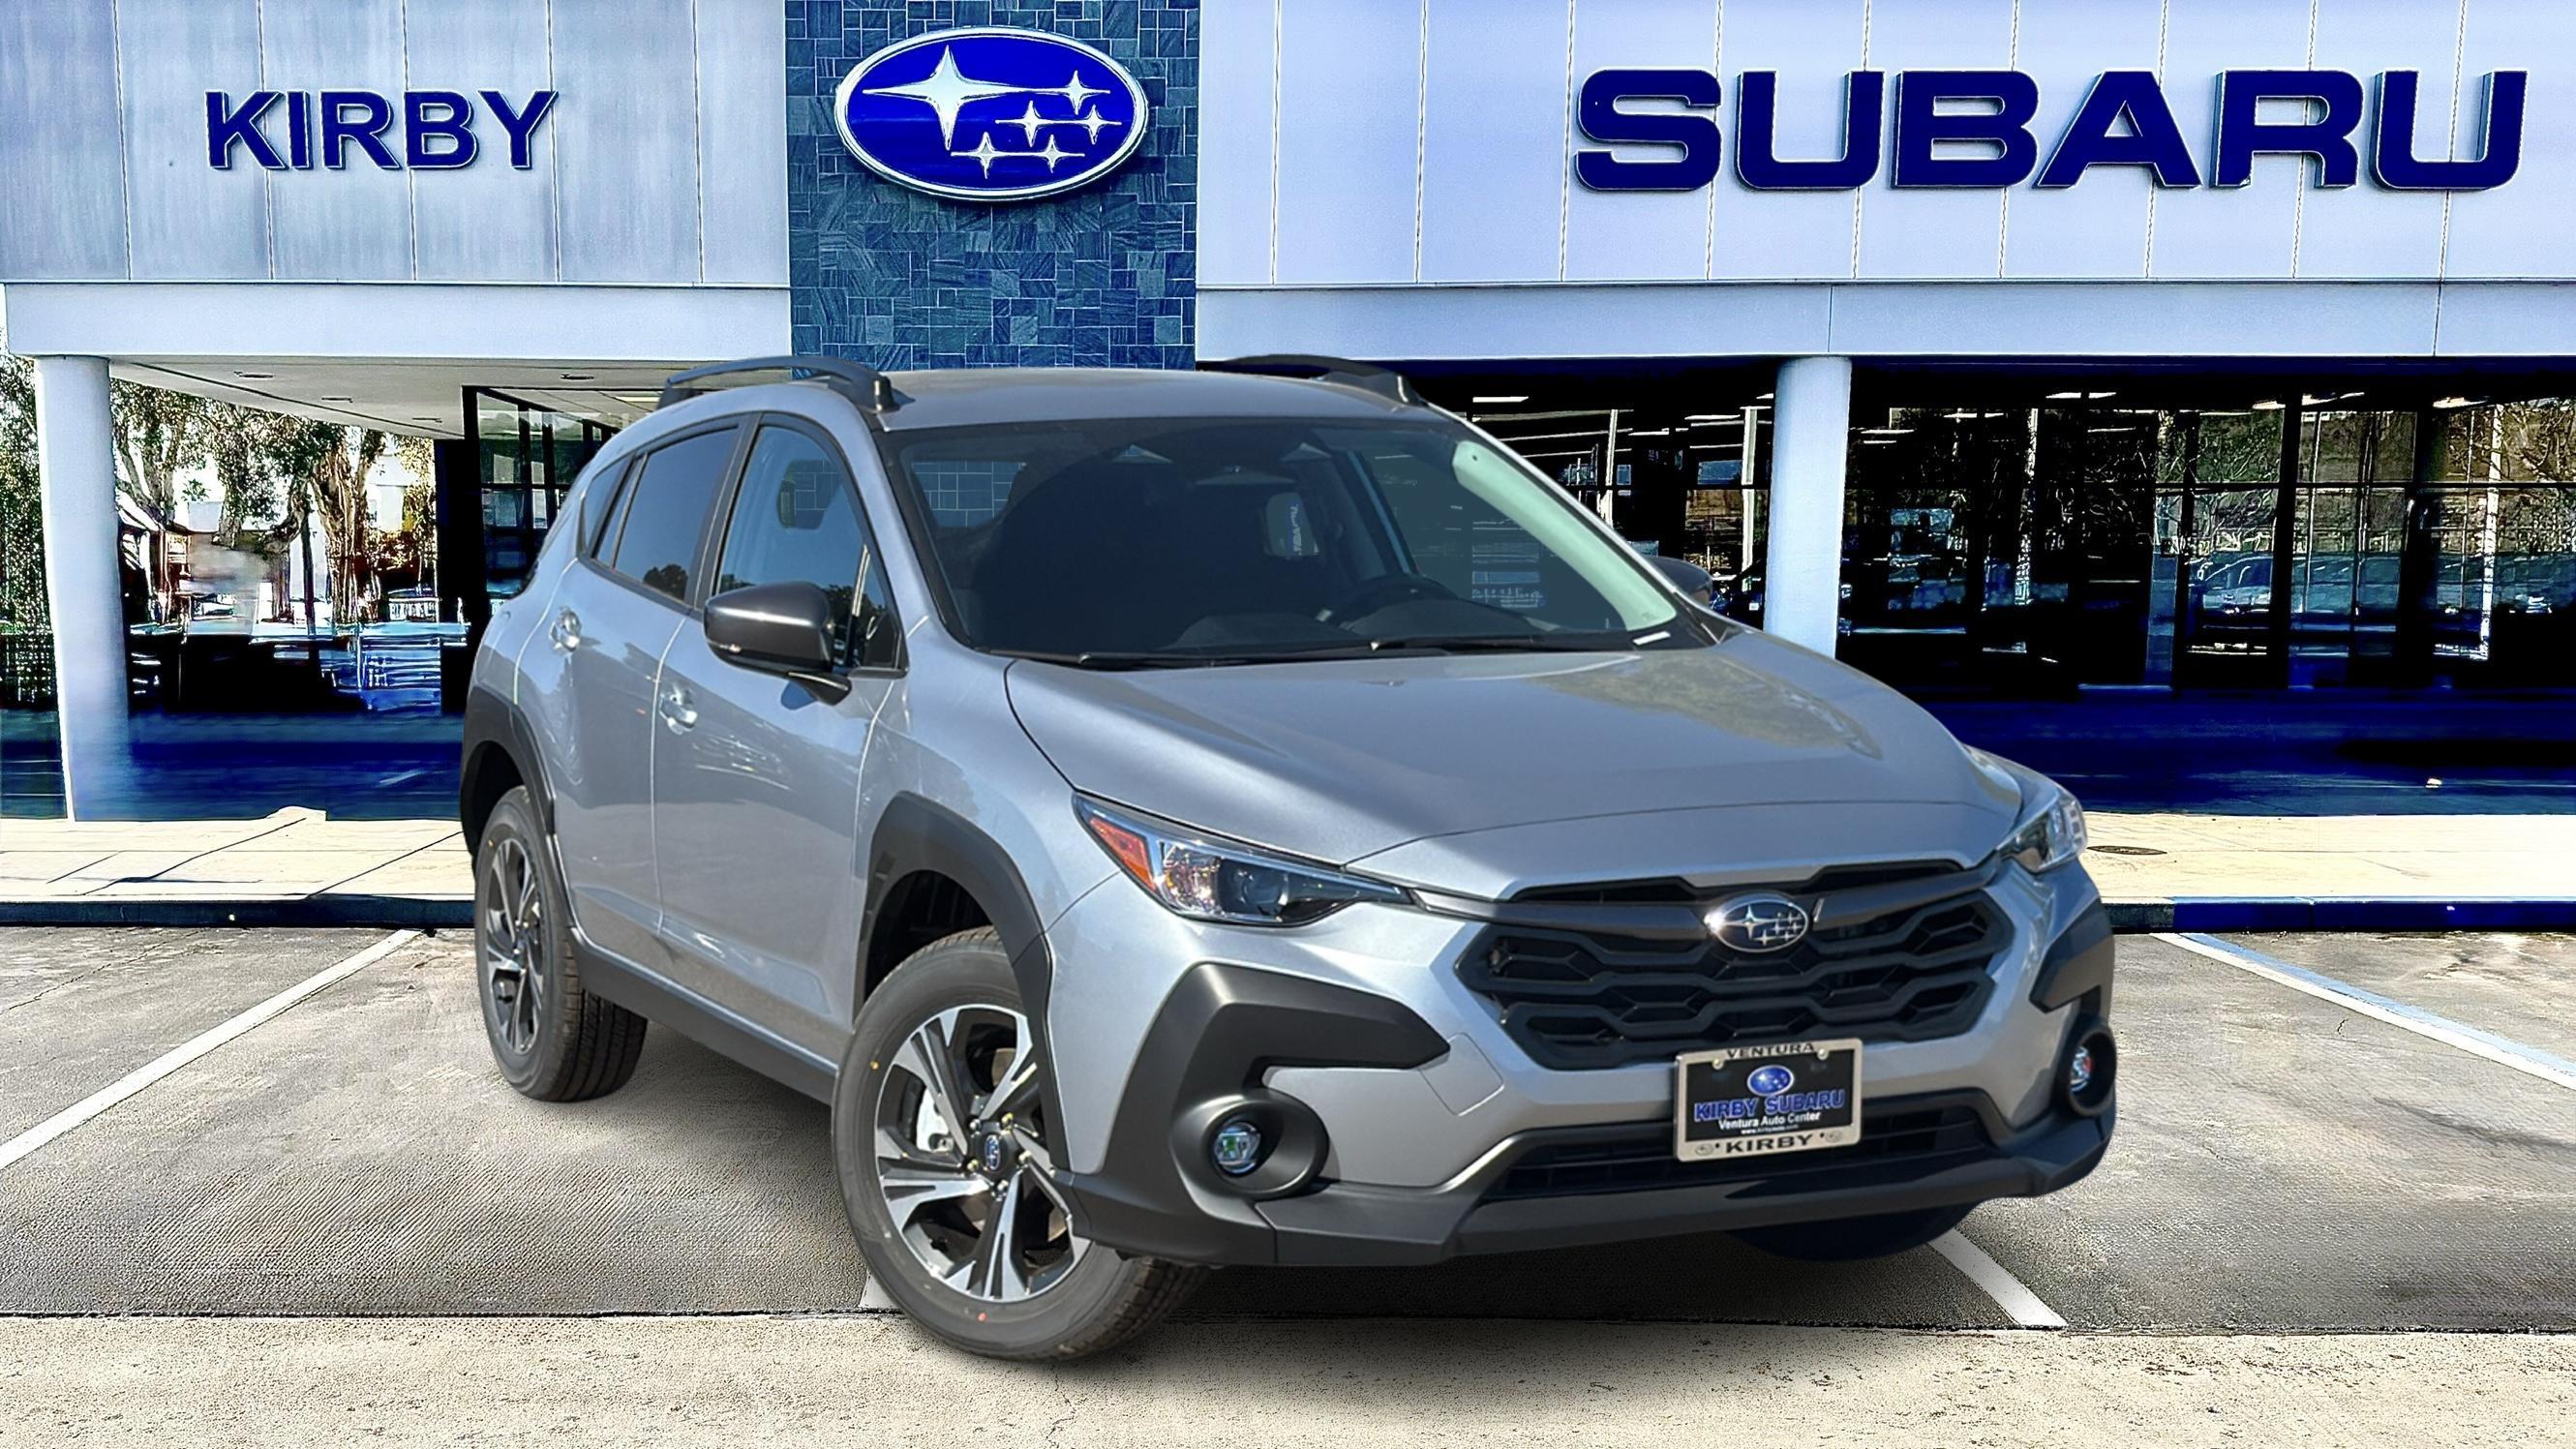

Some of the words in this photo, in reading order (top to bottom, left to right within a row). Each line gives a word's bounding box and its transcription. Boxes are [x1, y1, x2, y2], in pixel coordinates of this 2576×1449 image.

[206, 91, 560, 171] KIRBY
[1574, 69, 2527, 194] SUBARU
[1727, 1042, 1814, 1059] VENTURA
[1694, 1097, 1759, 1122] KIRBY
[1765, 1089, 1845, 1115] SUBARU
[1718, 1117, 1759, 1131] Ventura
[1760, 1115, 1785, 1127] Auto
[1787, 1111, 1821, 1123] Center
[1726, 1132, 1813, 1153] KIRBY
